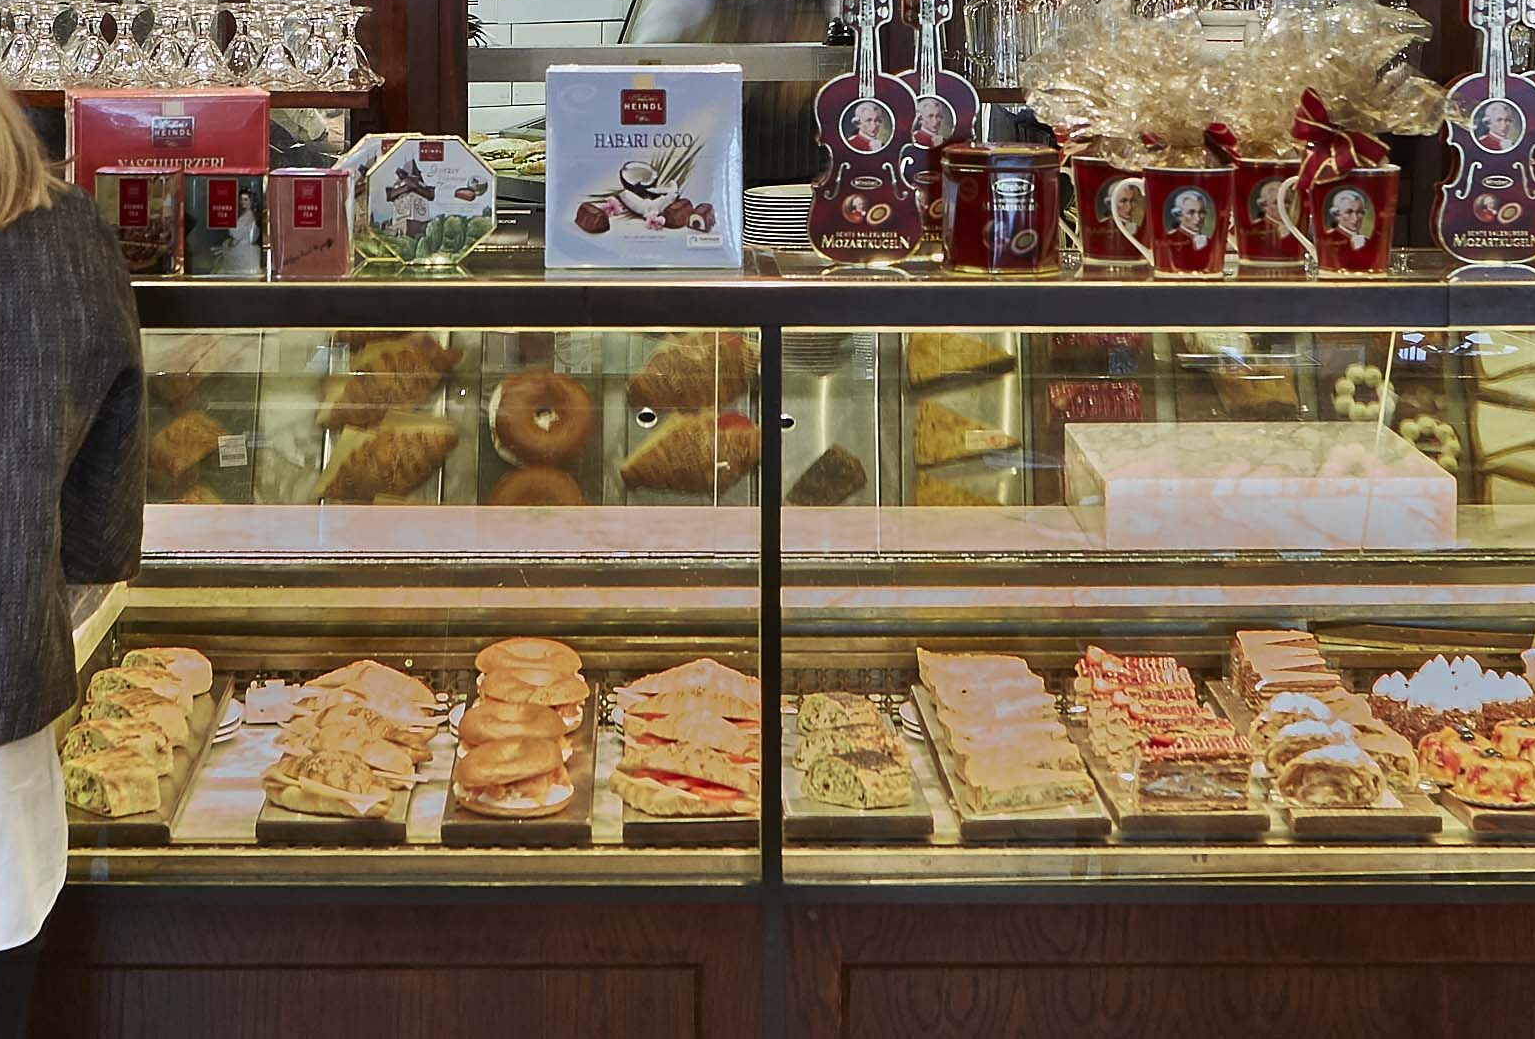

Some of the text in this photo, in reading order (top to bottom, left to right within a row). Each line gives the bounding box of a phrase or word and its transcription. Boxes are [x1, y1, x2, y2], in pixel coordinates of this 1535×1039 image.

[623, 103, 664, 112] HEINDL
[593, 133, 694, 149] HABARI COCO
[821, 234, 911, 250] MOZARTKUGELN
